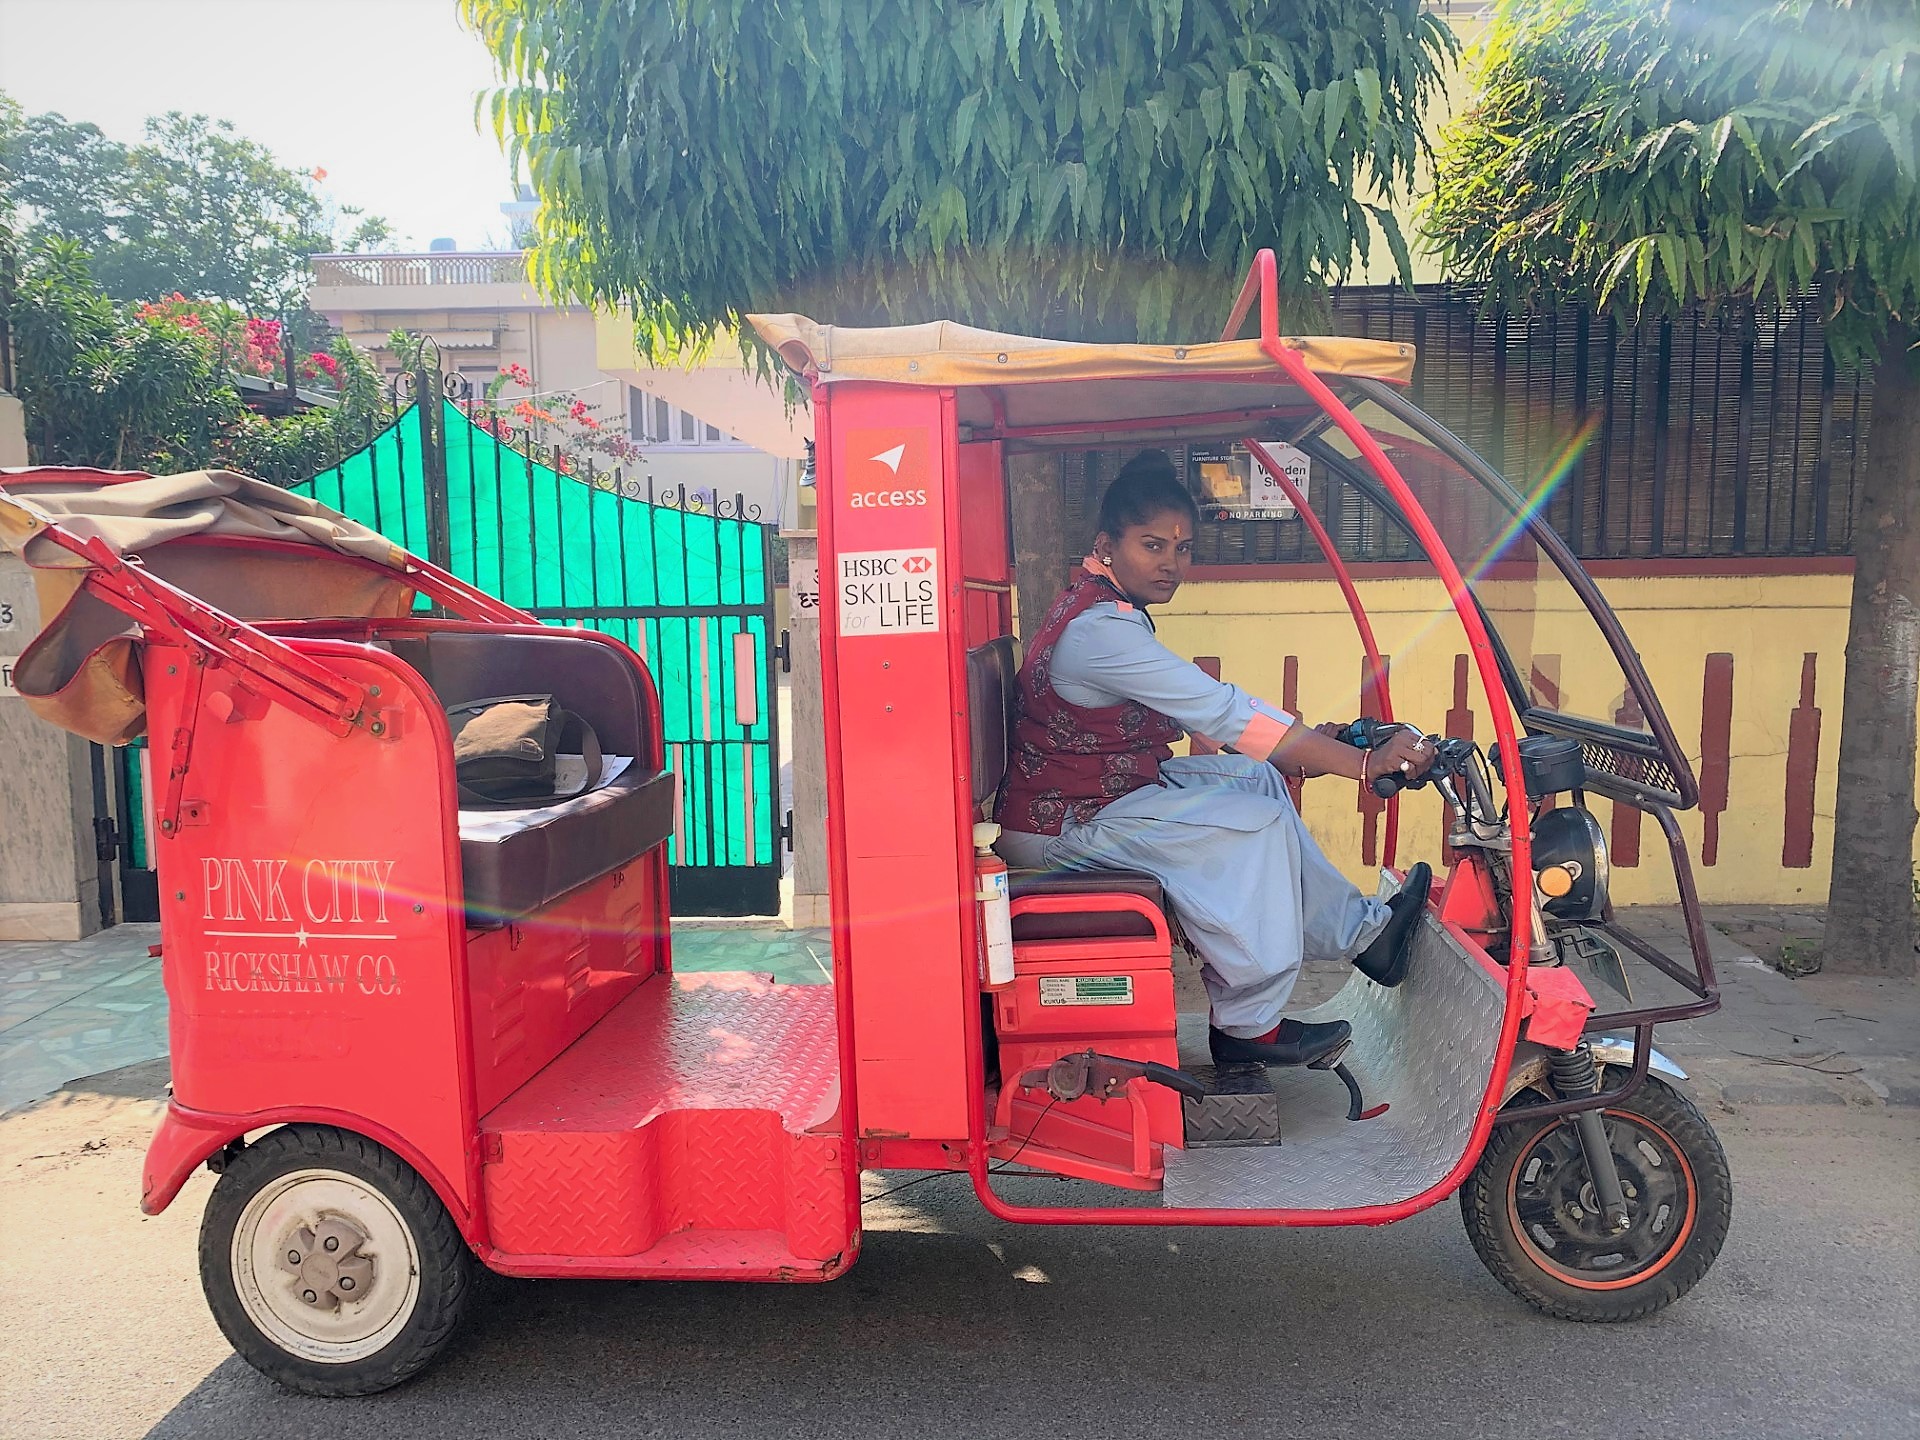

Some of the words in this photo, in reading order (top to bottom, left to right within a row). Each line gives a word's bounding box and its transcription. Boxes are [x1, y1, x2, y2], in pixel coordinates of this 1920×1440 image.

[850, 489, 927, 508] access
[1243, 510, 1283, 518] PARKING
[843, 558, 898, 577] HSBC
[844, 580, 933, 606] SKILLS
[844, 612, 870, 629] for
[880, 604, 934, 627] LIFE
[200, 857, 294, 922] PINK
[302, 859, 396, 924] CITY
[204, 951, 350, 993] RICKSHAW
[356, 954, 401, 996] CO.
